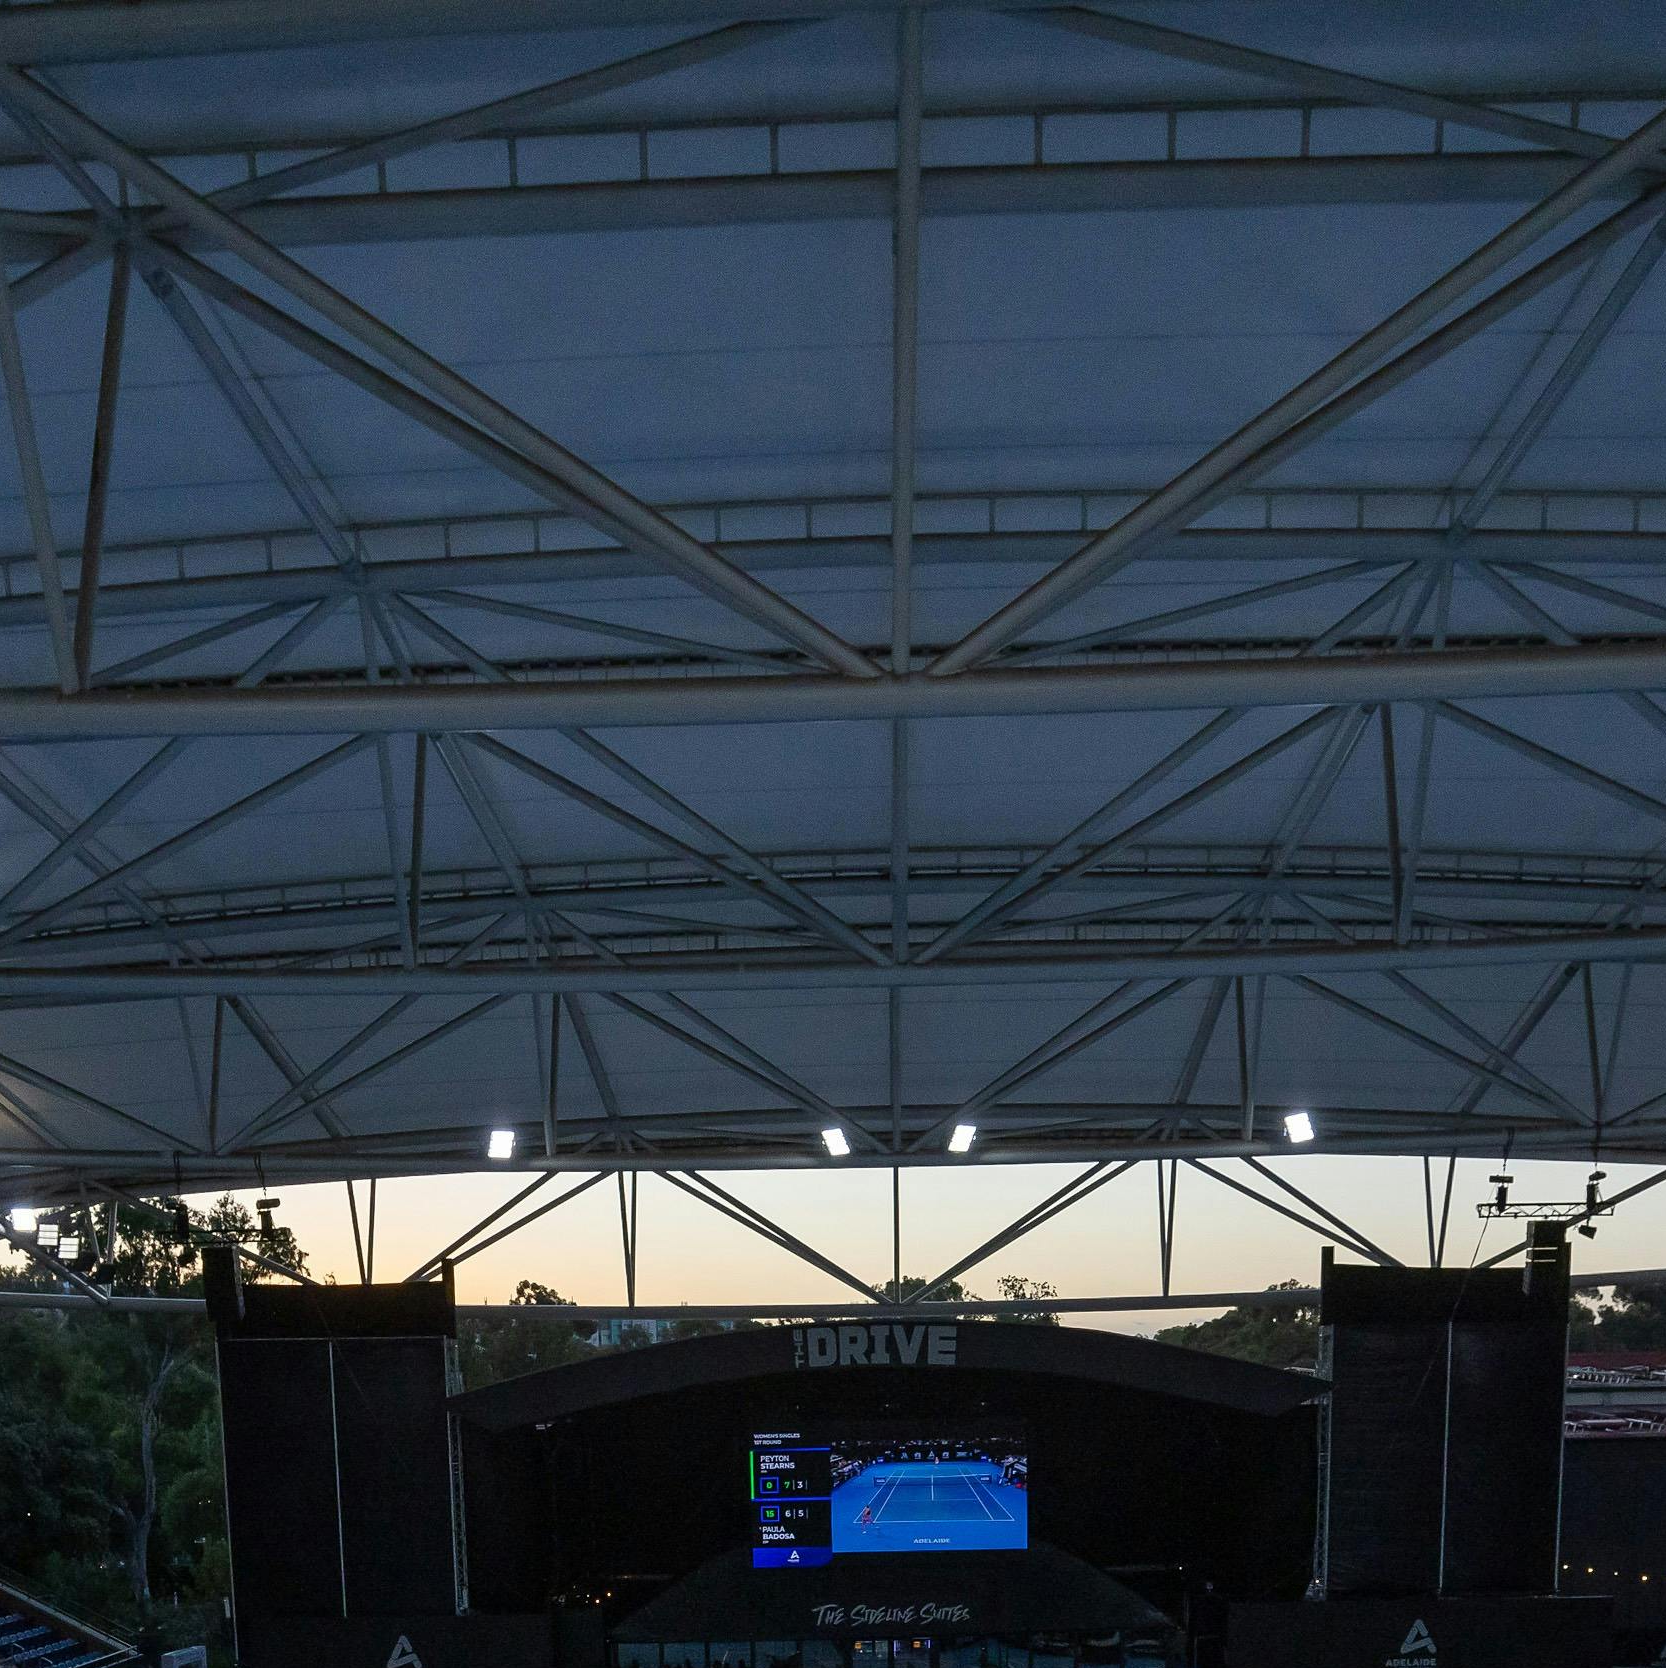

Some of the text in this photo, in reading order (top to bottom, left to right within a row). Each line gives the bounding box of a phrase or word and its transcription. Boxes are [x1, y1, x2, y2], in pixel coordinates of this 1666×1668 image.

[807, 1325, 957, 1367] DRIVE
[760, 1455, 790, 1463] PEYTON
[760, 1462, 795, 1470] STEARNS
[766, 1481, 803, 1489] 0 7 3
[765, 1510, 775, 1518] 15
[785, 1510, 791, 1518] 6
[1384, 1658, 1437, 1667] ADELAIDE
